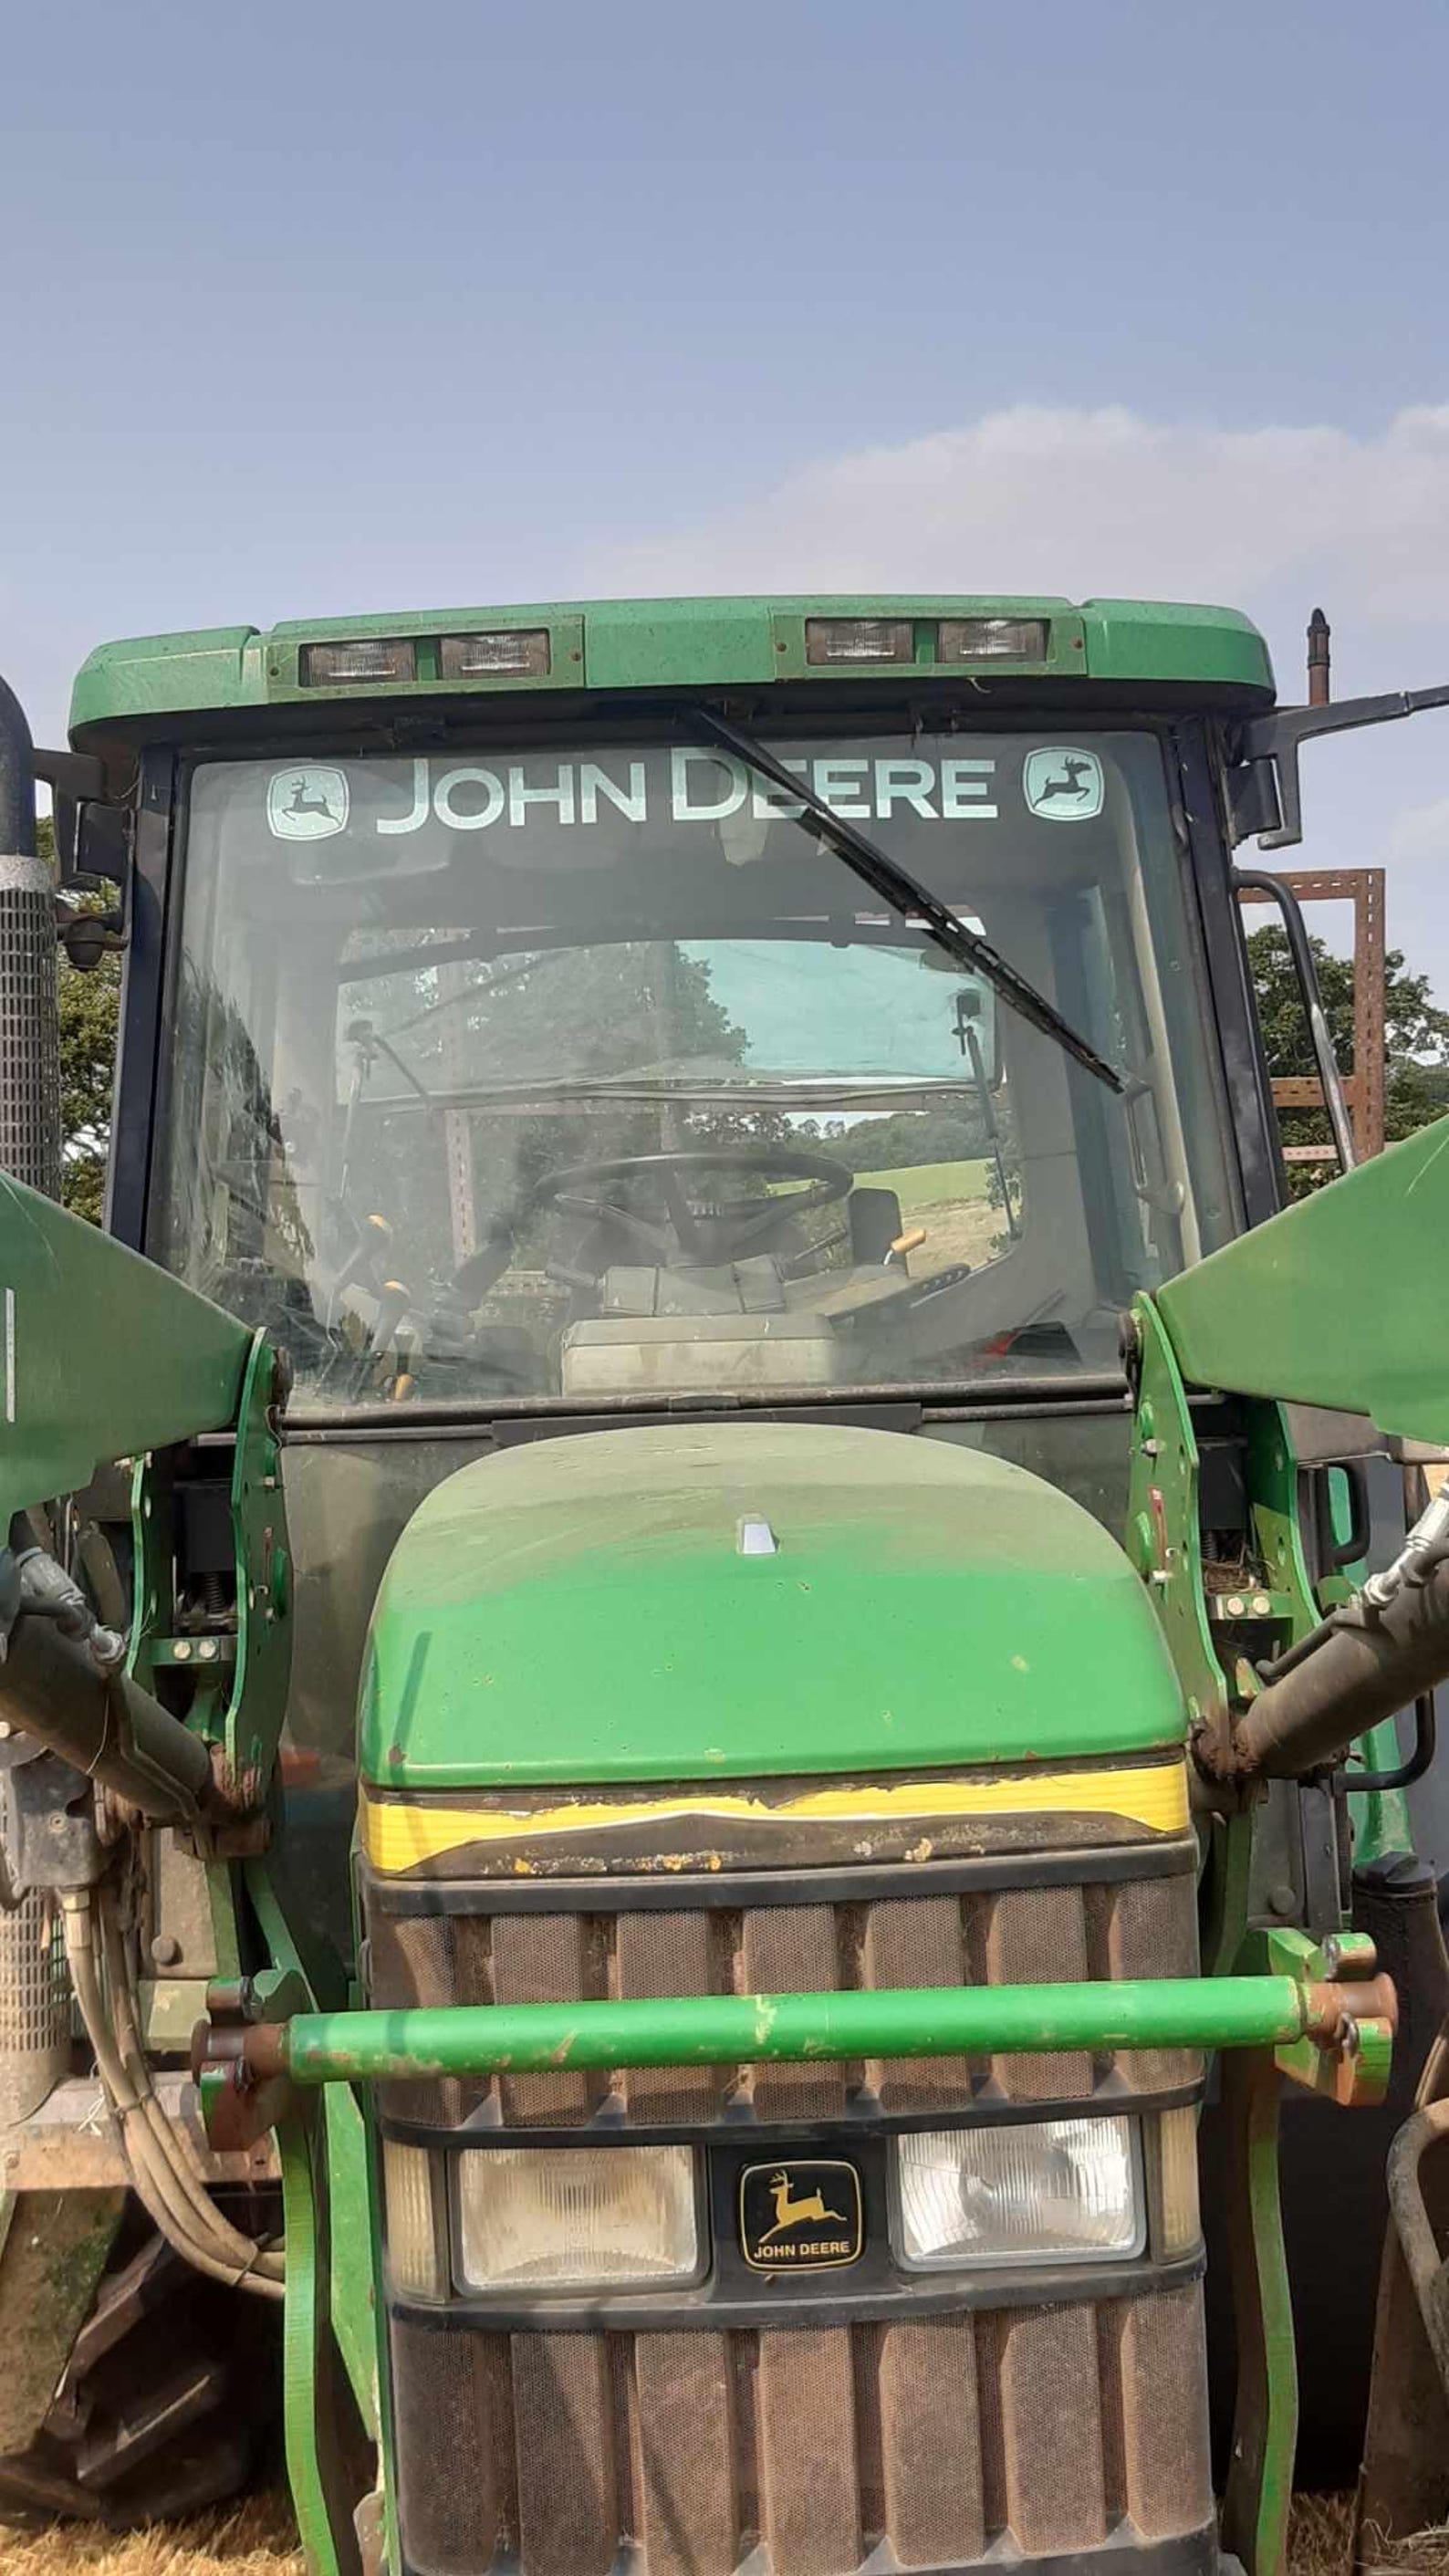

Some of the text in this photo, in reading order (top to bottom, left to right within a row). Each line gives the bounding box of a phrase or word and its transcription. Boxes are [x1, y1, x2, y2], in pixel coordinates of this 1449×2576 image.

[377, 746, 998, 834] JOHN DEERE
[754, 2241, 850, 2258] JOHN DEERE
